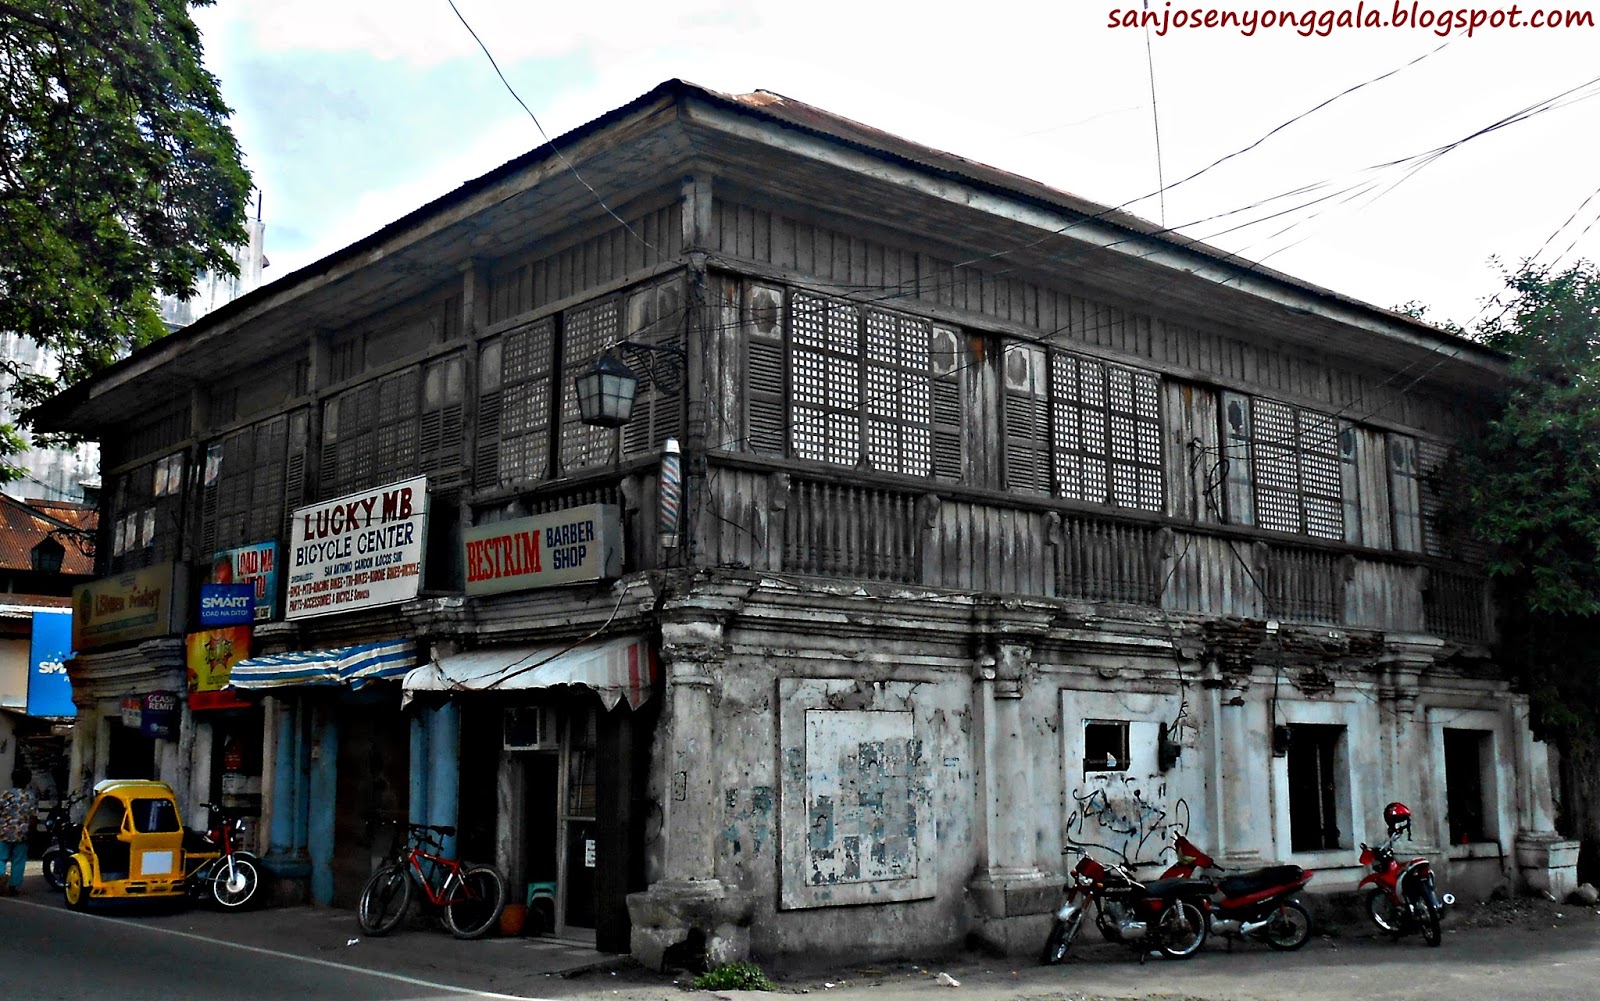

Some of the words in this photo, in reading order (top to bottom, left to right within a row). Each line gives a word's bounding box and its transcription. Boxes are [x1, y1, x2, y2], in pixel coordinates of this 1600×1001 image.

[304, 496, 378, 541] LUCKY
[381, 487, 413, 524] MB
[296, 536, 352, 567] BICYCLE
[357, 522, 414, 554] CENTER
[466, 529, 542, 583] BESTRIM
[546, 520, 595, 548] BARBER
[553, 545, 587, 570] SHOP
[202, 596, 250, 609] SMART
[231, 609, 249, 617] DITO!
[148, 694, 176, 704] GCASH
[148, 702, 175, 710] REMIT
